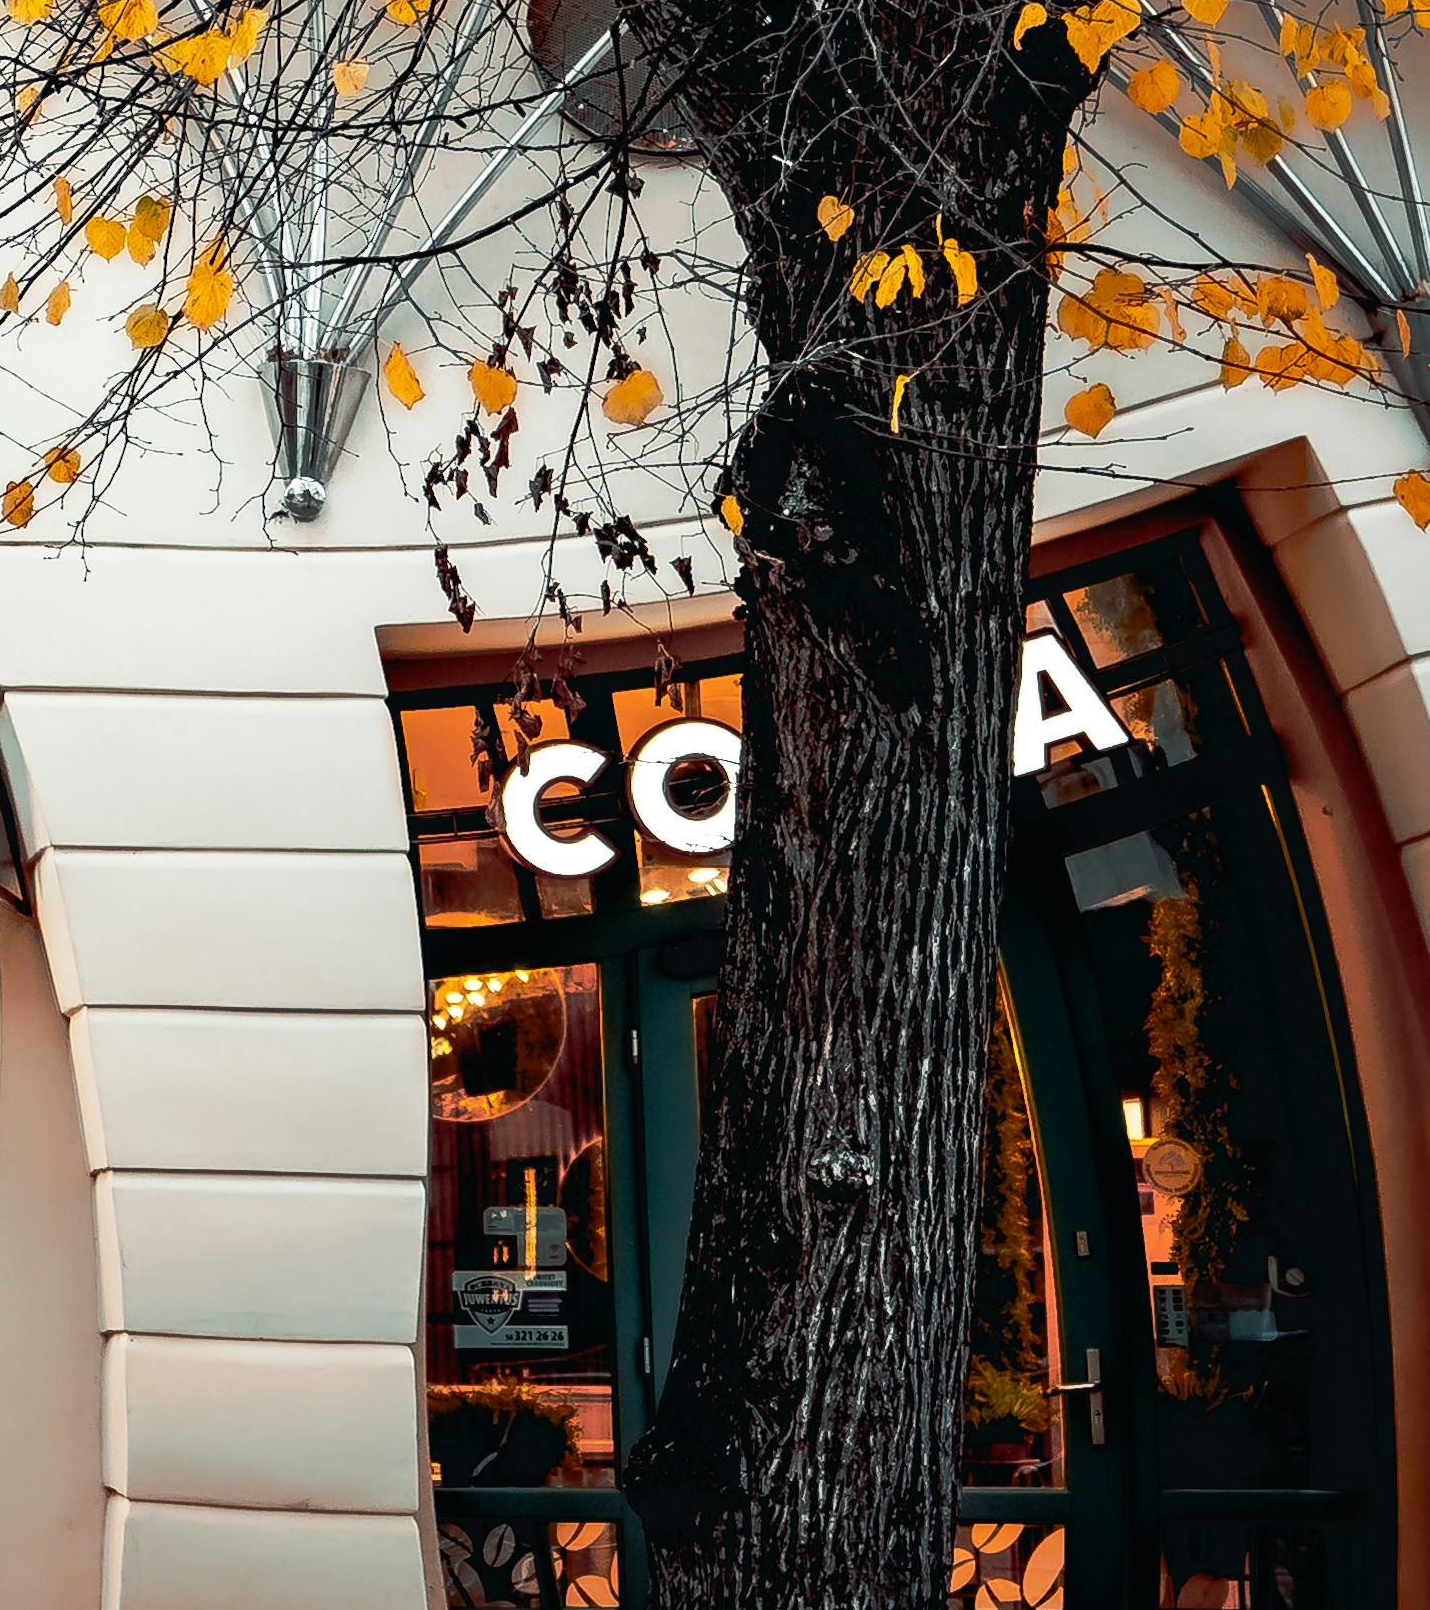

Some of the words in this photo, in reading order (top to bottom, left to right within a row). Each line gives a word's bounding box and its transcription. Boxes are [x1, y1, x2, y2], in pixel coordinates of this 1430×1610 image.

[501, 629, 1130, 878] COA
[515, 1330, 533, 1342] 321
[536, 1330, 549, 1342] 26
[551, 1330, 565, 1342] 26
